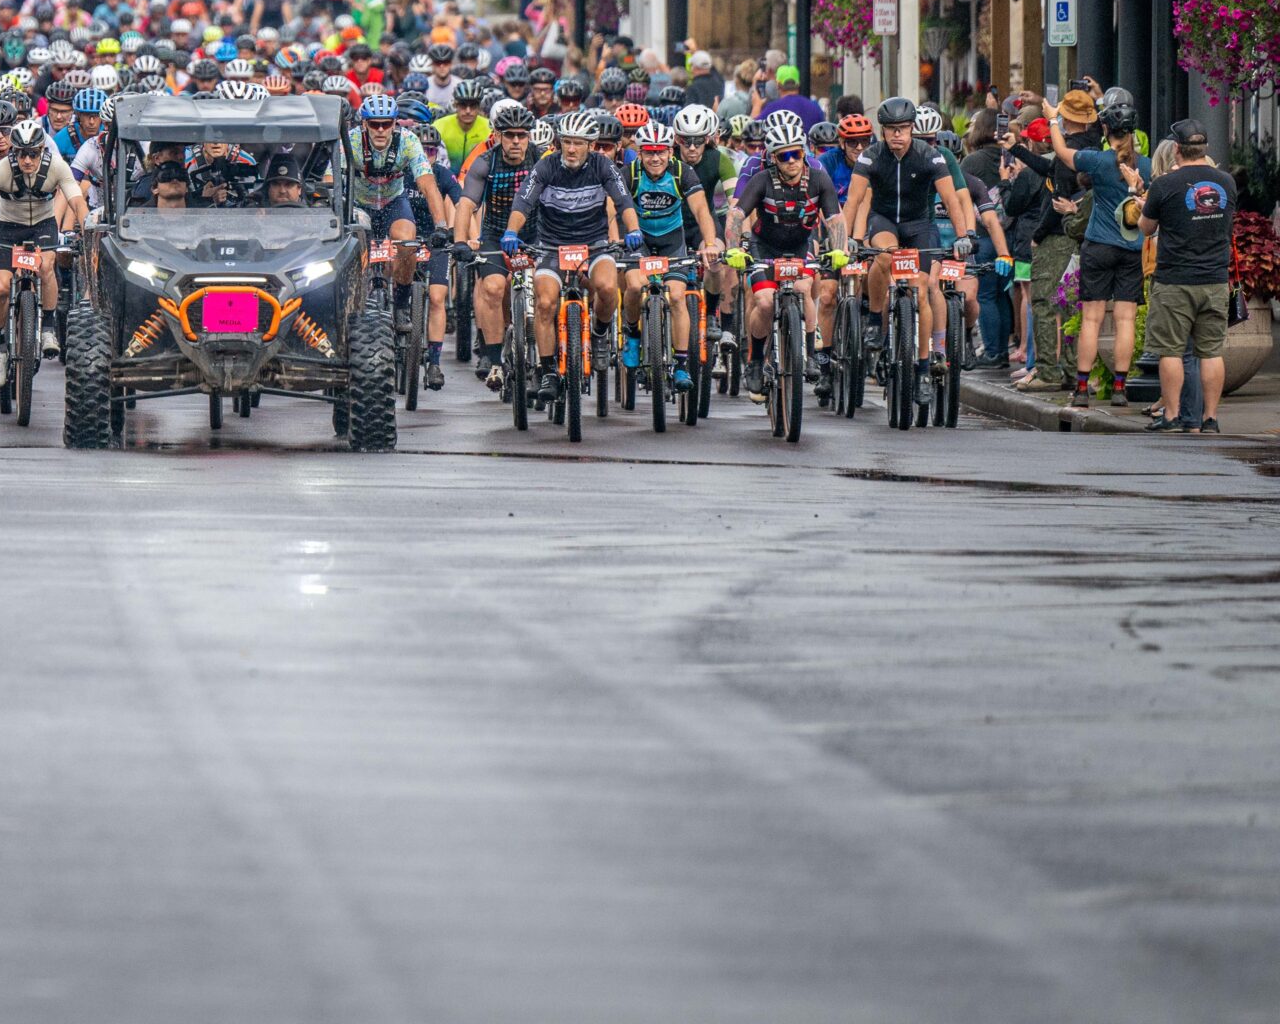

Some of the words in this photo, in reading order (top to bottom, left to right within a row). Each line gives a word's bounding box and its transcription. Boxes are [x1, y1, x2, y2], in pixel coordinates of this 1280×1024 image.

[640, 193, 673, 205] Smith's
[370, 250, 388, 259] 352
[564, 253, 583, 261] 444
[17, 256, 35, 266] 429
[645, 260, 663, 270] 879
[894, 259, 915, 270] 1126
[780, 265, 799, 276] 286
[942, 267, 960, 277] 243
